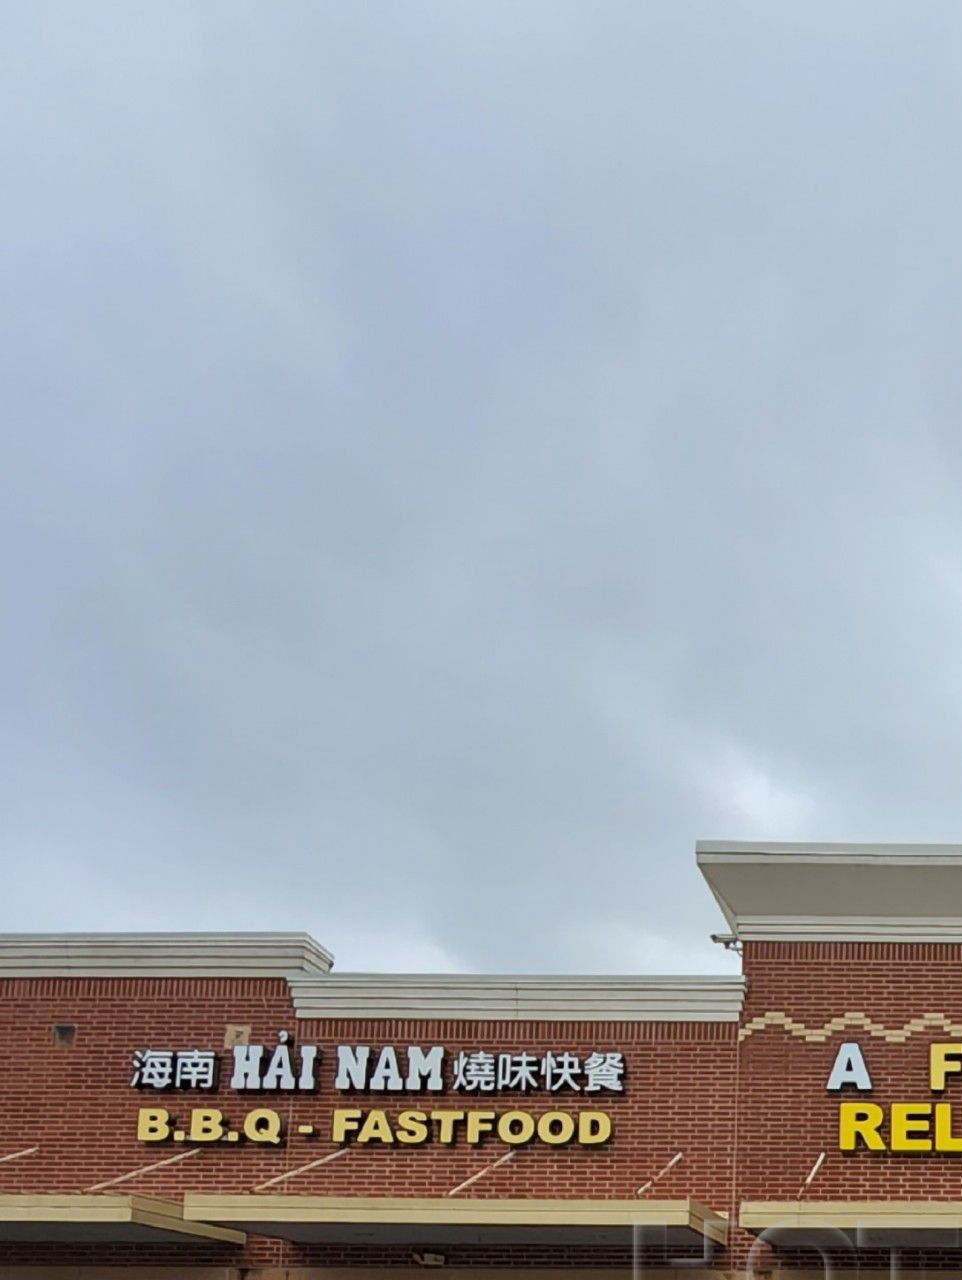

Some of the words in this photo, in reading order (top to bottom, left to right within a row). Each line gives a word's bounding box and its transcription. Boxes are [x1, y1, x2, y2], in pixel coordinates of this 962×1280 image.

[130, 1049, 216, 1088] 海南
[335, 1045, 444, 1090] NAM
[452, 1051, 624, 1092] 燒味快餐
[826, 1042, 873, 1090] A
[332, 1110, 612, 1145] FASTFOOD
